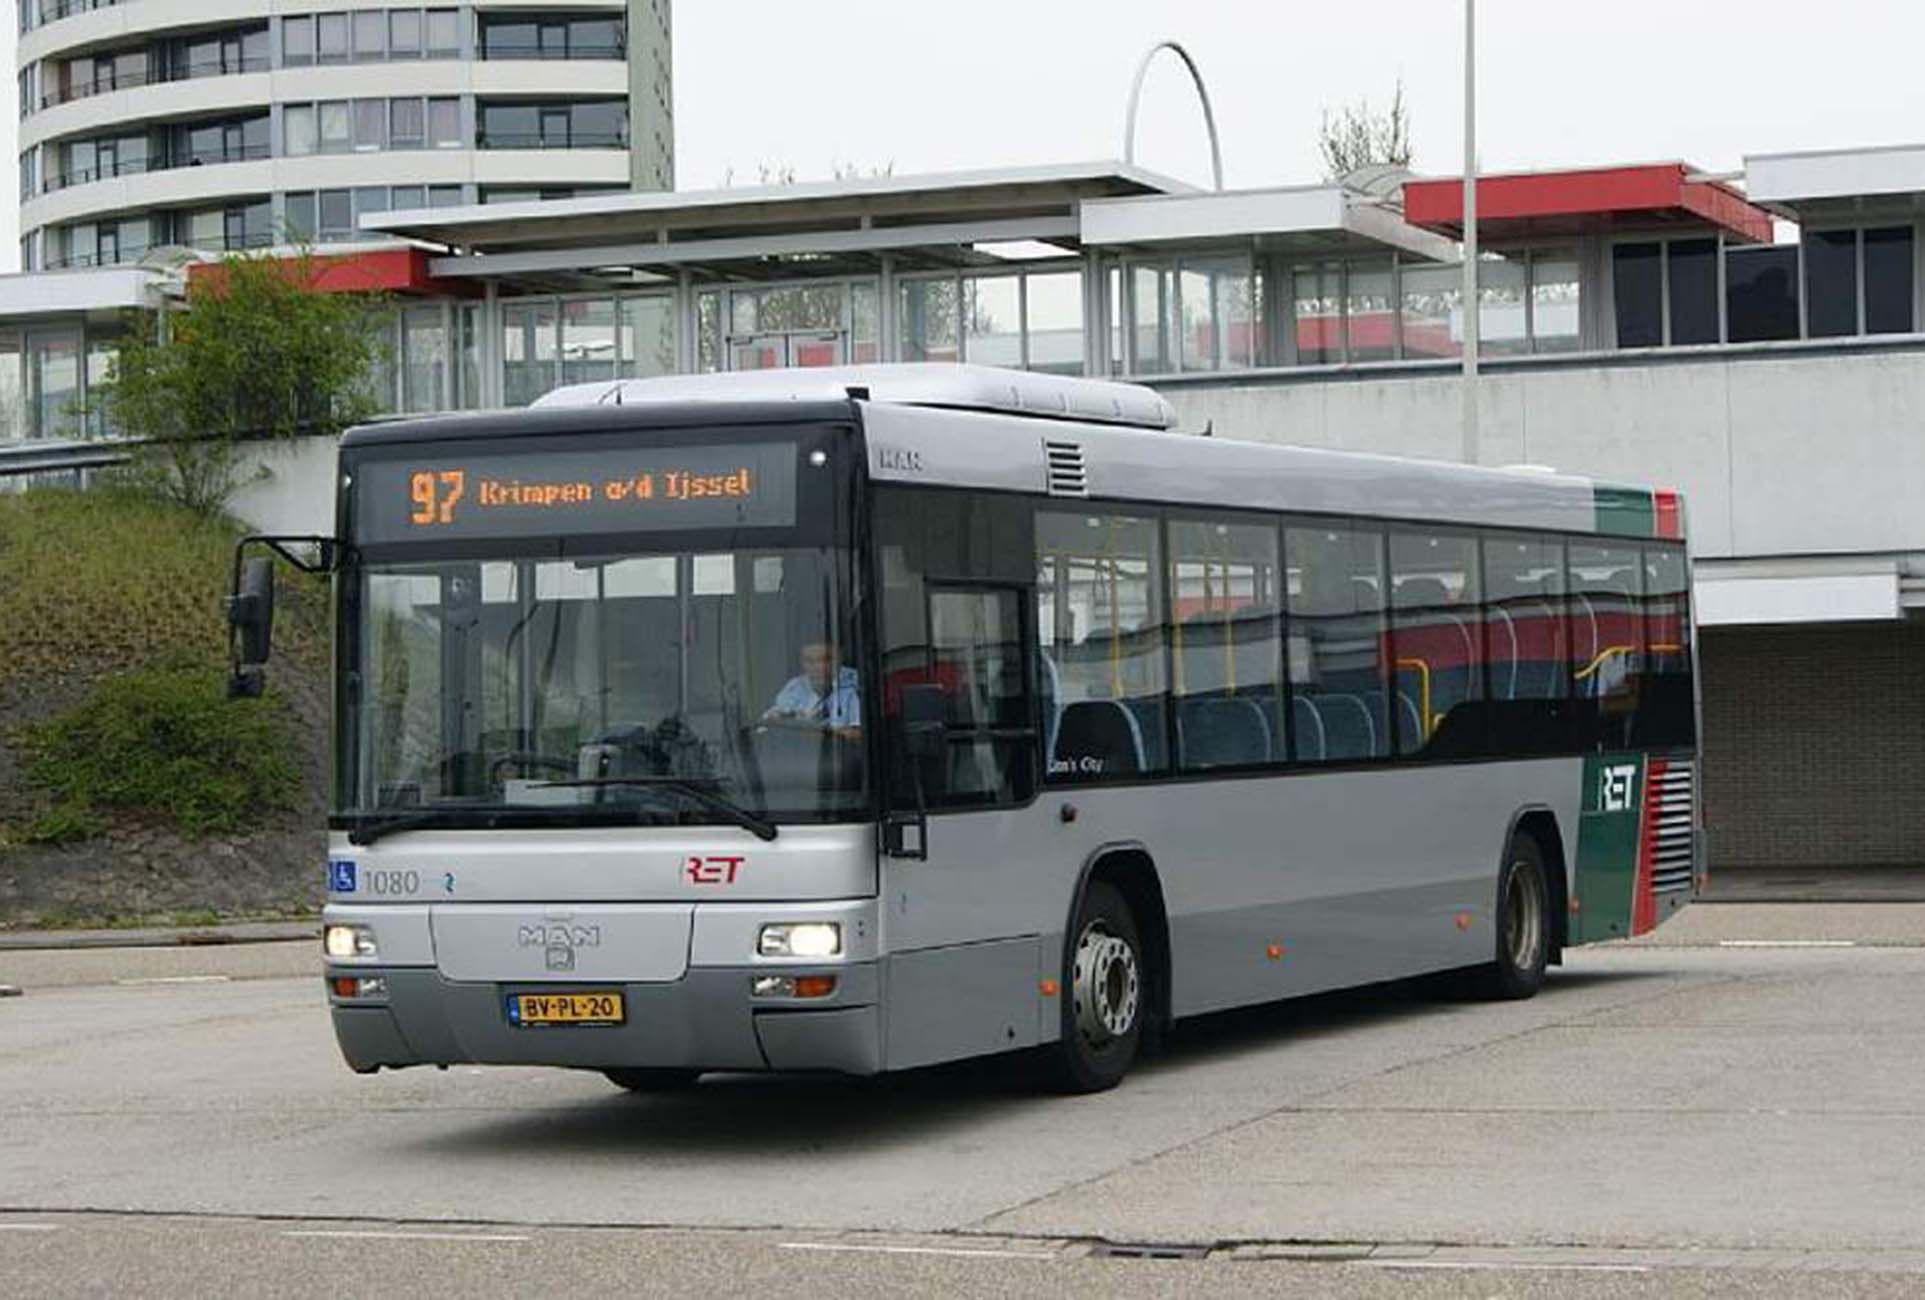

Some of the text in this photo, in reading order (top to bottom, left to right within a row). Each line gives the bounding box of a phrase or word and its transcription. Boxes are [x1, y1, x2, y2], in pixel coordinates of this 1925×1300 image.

[410, 470, 463, 525] 97
[479, 480, 592, 505] Krimpen
[1598, 765, 1636, 811] RET
[364, 871, 420, 894] 1080
[679, 856, 745, 884] RET
[518, 925, 600, 947] MAN
[525, 997, 615, 1018] BV-PL-20
